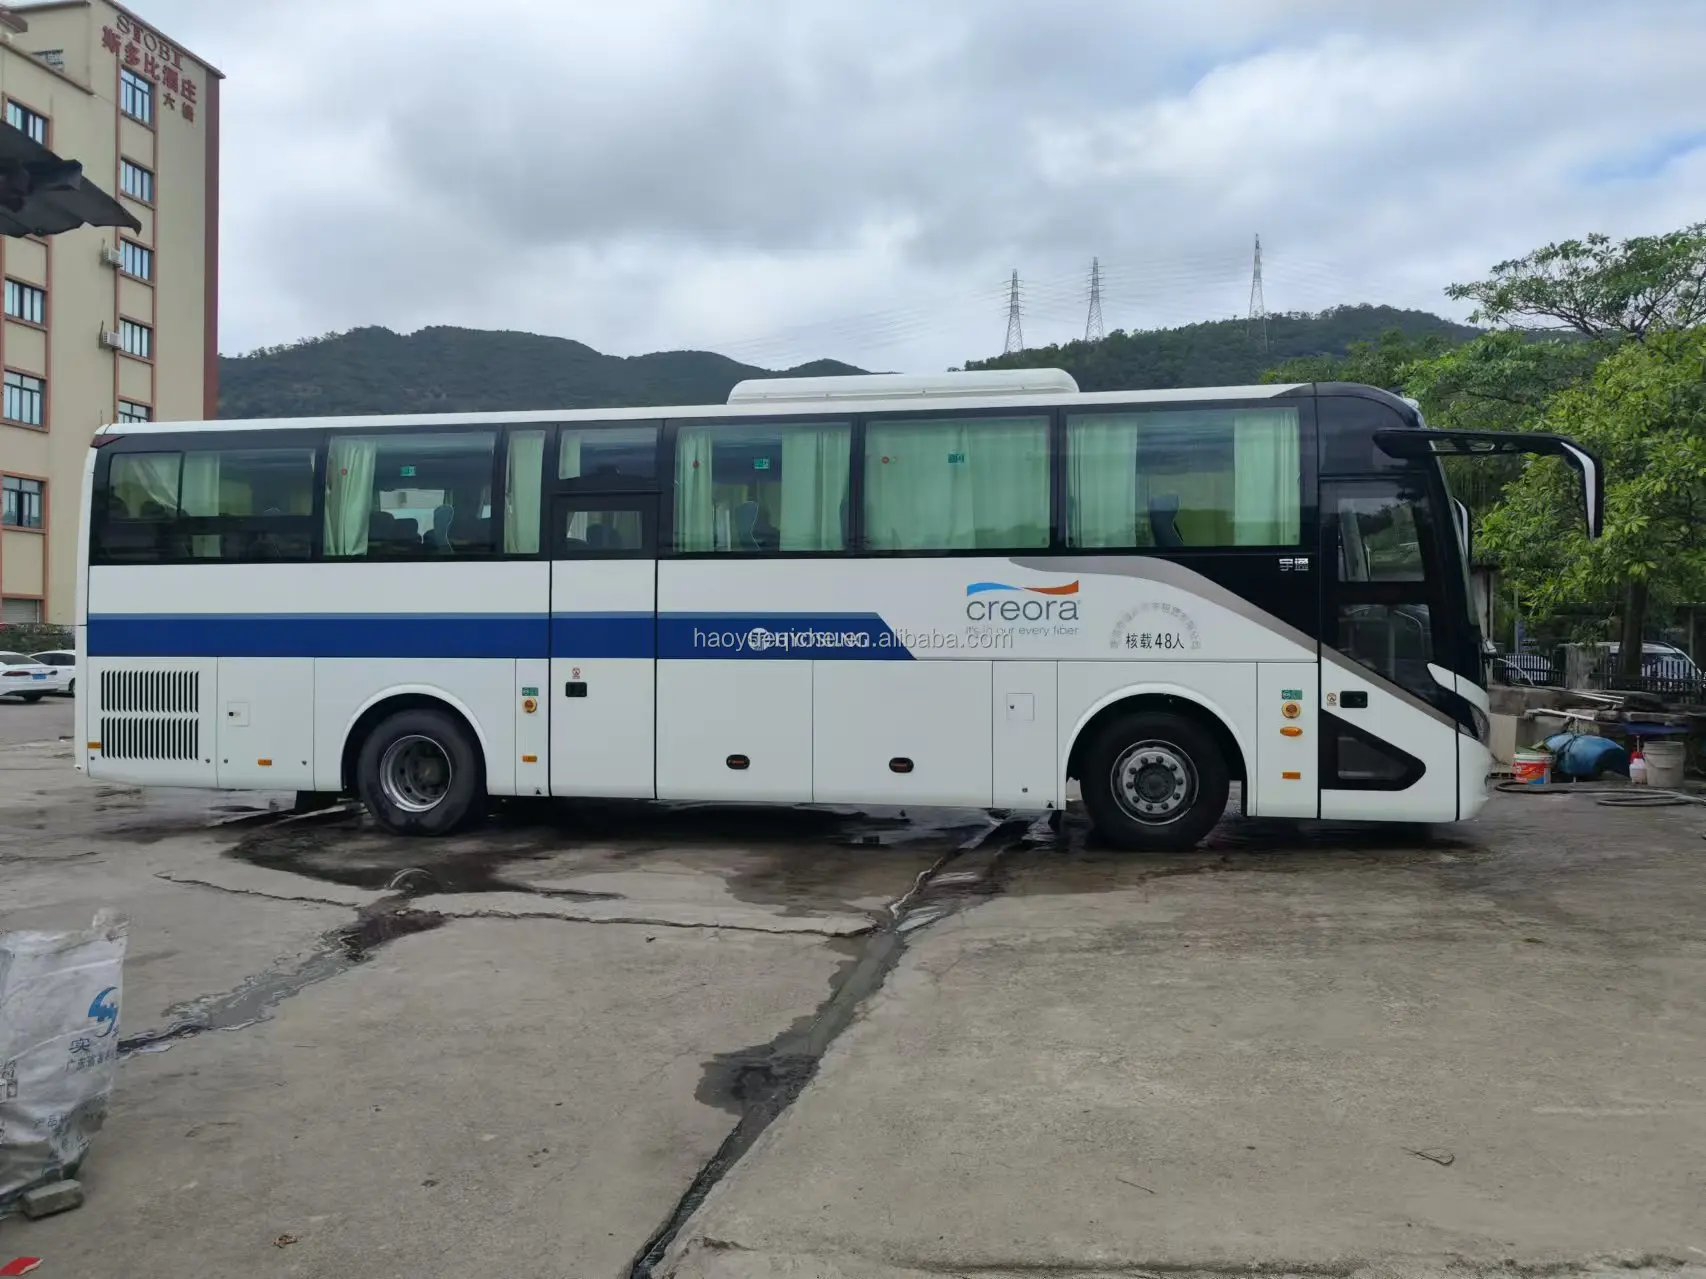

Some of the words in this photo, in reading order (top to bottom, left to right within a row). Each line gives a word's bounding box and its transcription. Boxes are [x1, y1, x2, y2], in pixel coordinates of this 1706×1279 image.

[1279, 558, 1309, 571] 宇通
[966, 600, 1079, 621] creora
[1018, 626, 1050, 637] every
[1053, 625, 1079, 636] fiber
